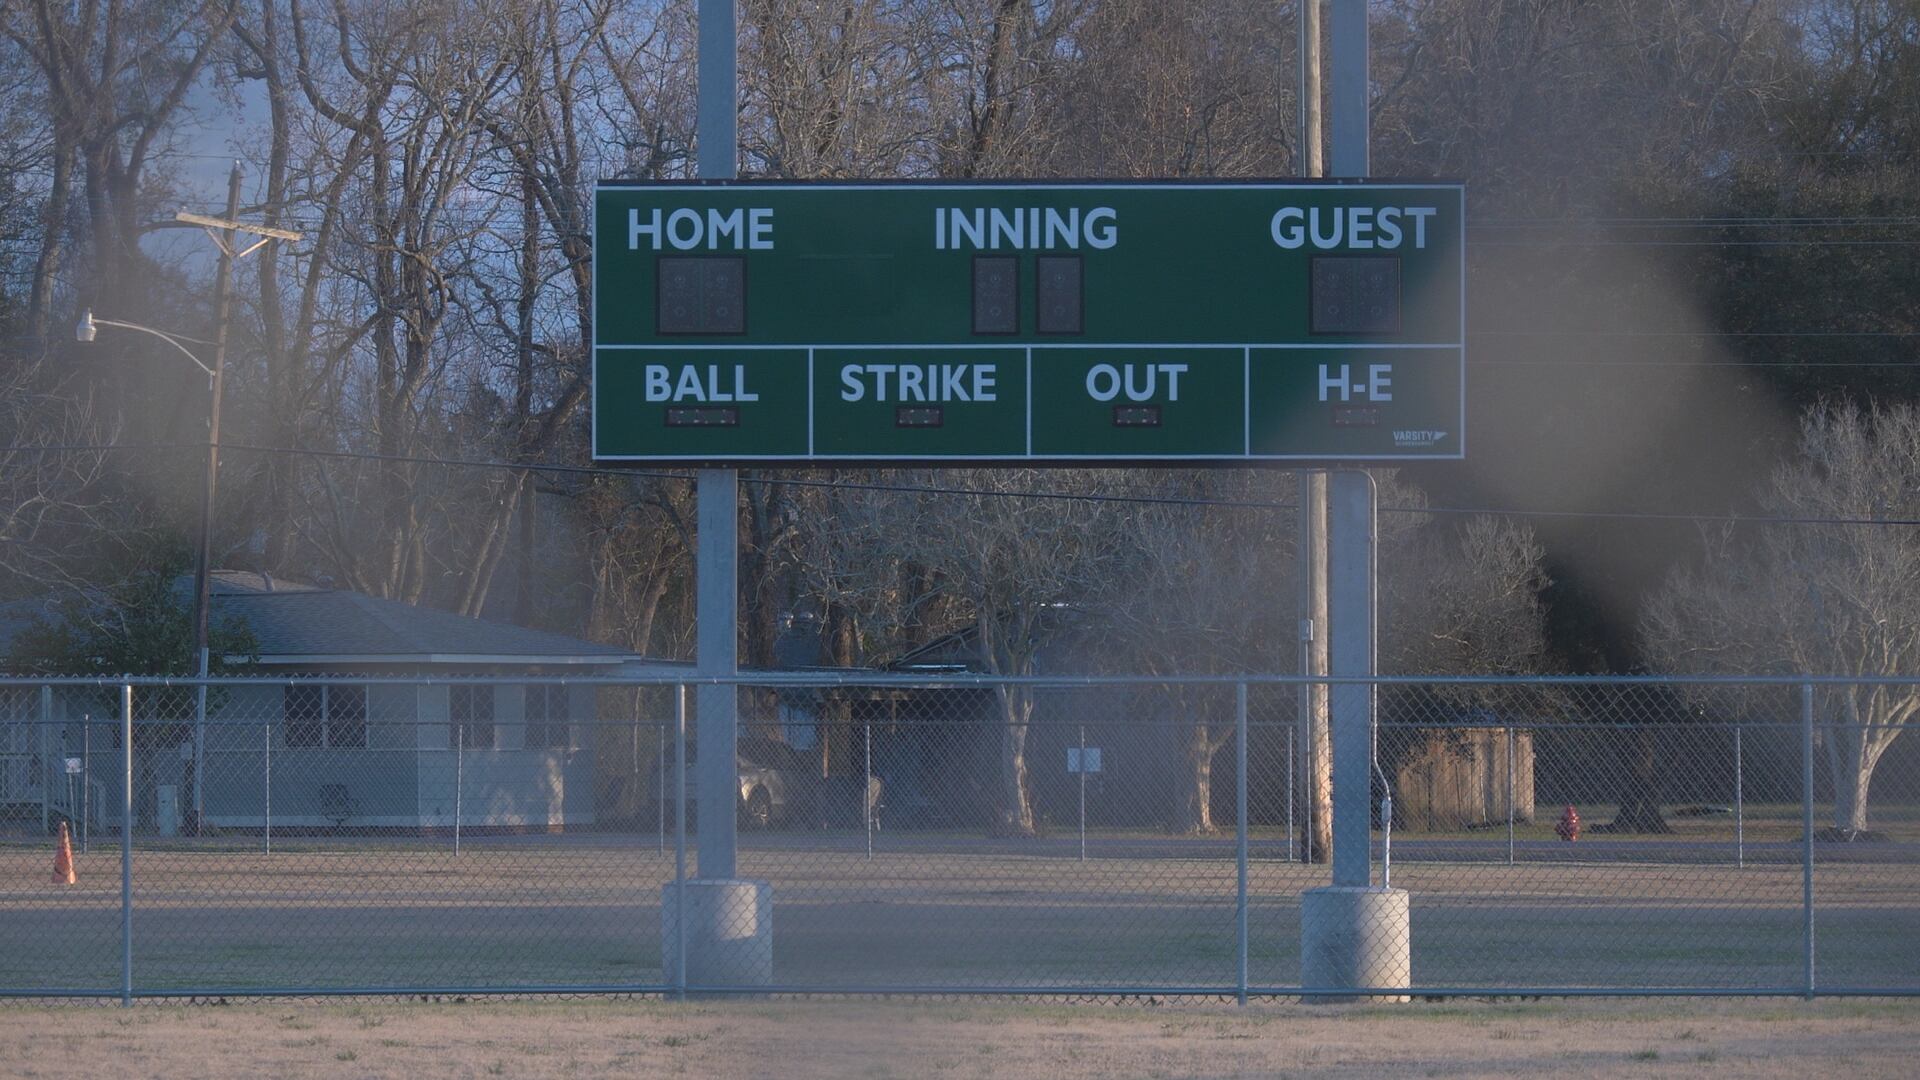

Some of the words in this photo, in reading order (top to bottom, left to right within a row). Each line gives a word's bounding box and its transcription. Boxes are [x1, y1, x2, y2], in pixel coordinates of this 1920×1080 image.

[628, 207, 775, 250] HOME
[935, 207, 1118, 250] INNING
[1270, 206, 1438, 251] GUEST
[644, 364, 760, 403] BALL
[840, 363, 998, 403] STRIKE
[1085, 363, 1189, 403] OUT
[1318, 363, 1394, 403] H-E
[1393, 431, 1433, 441] VARSITY
